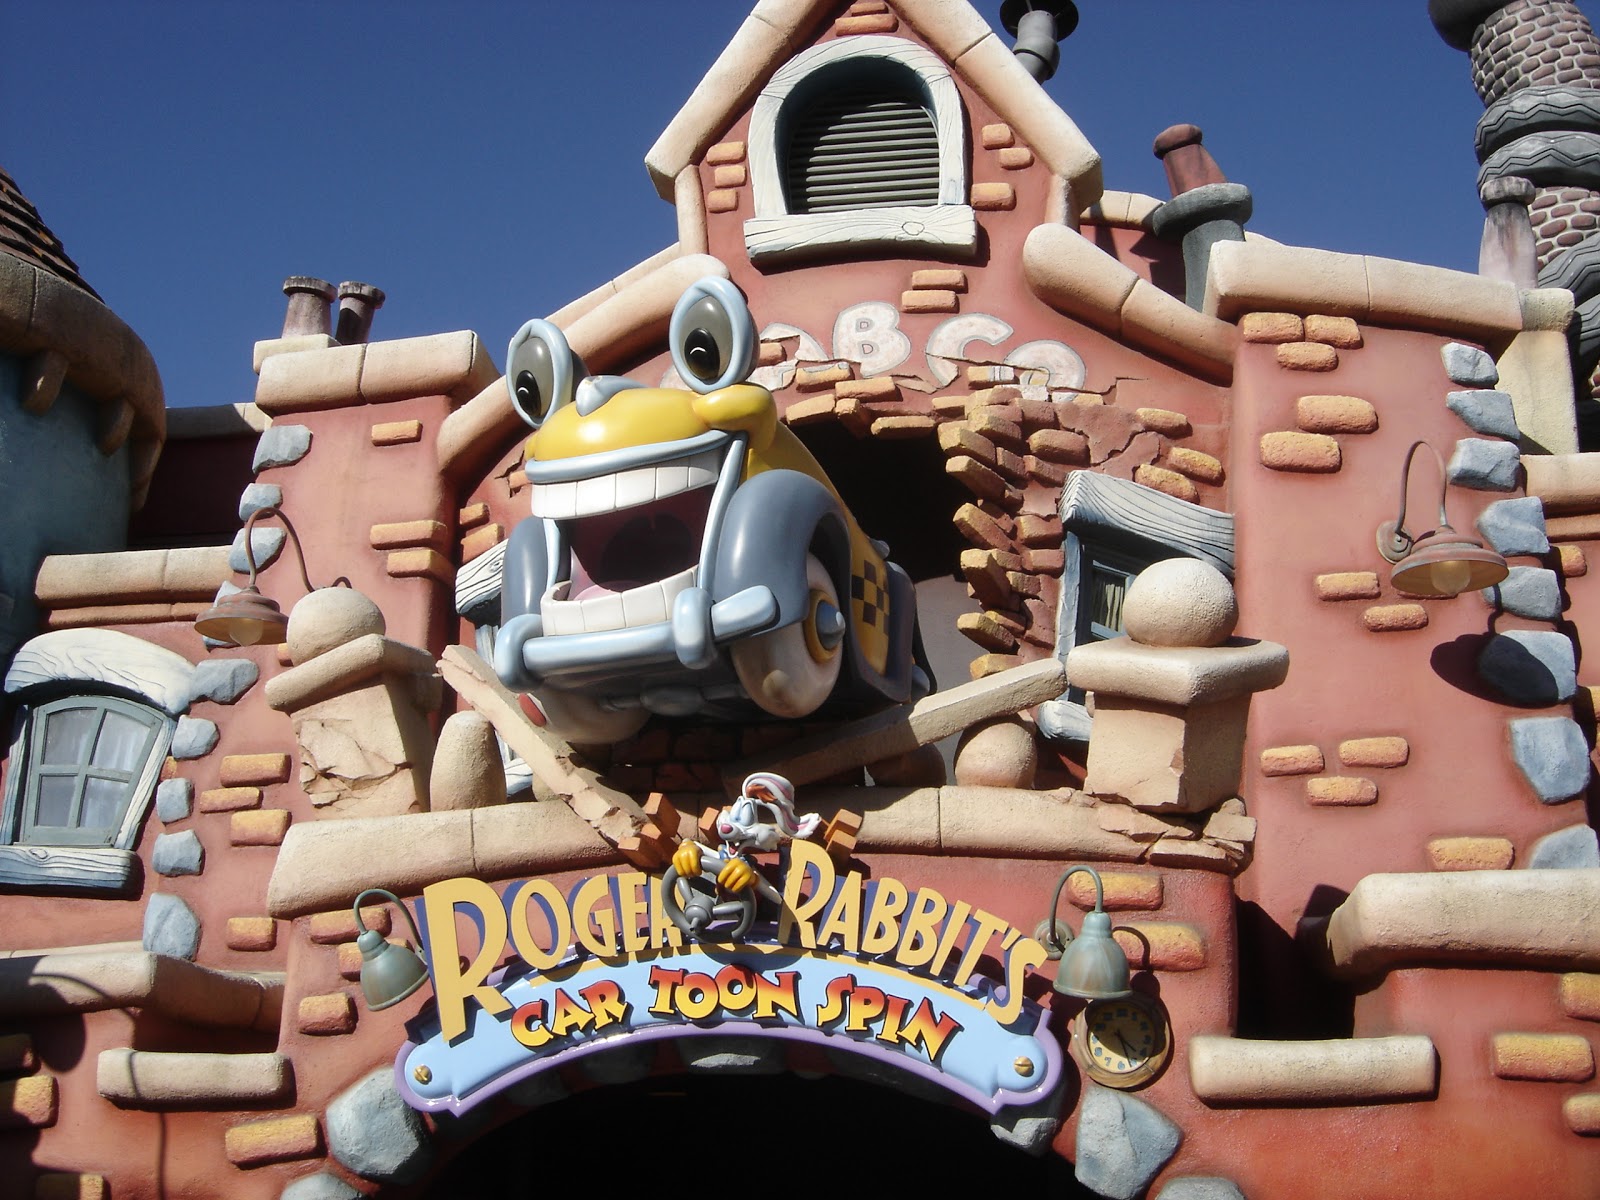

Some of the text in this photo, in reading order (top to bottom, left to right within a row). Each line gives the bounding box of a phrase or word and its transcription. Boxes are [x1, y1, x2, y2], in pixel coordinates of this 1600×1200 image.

[423, 839, 1048, 1042] ROGER RABBIT'S
[511, 963, 962, 1061] CAR TOON SPIN
